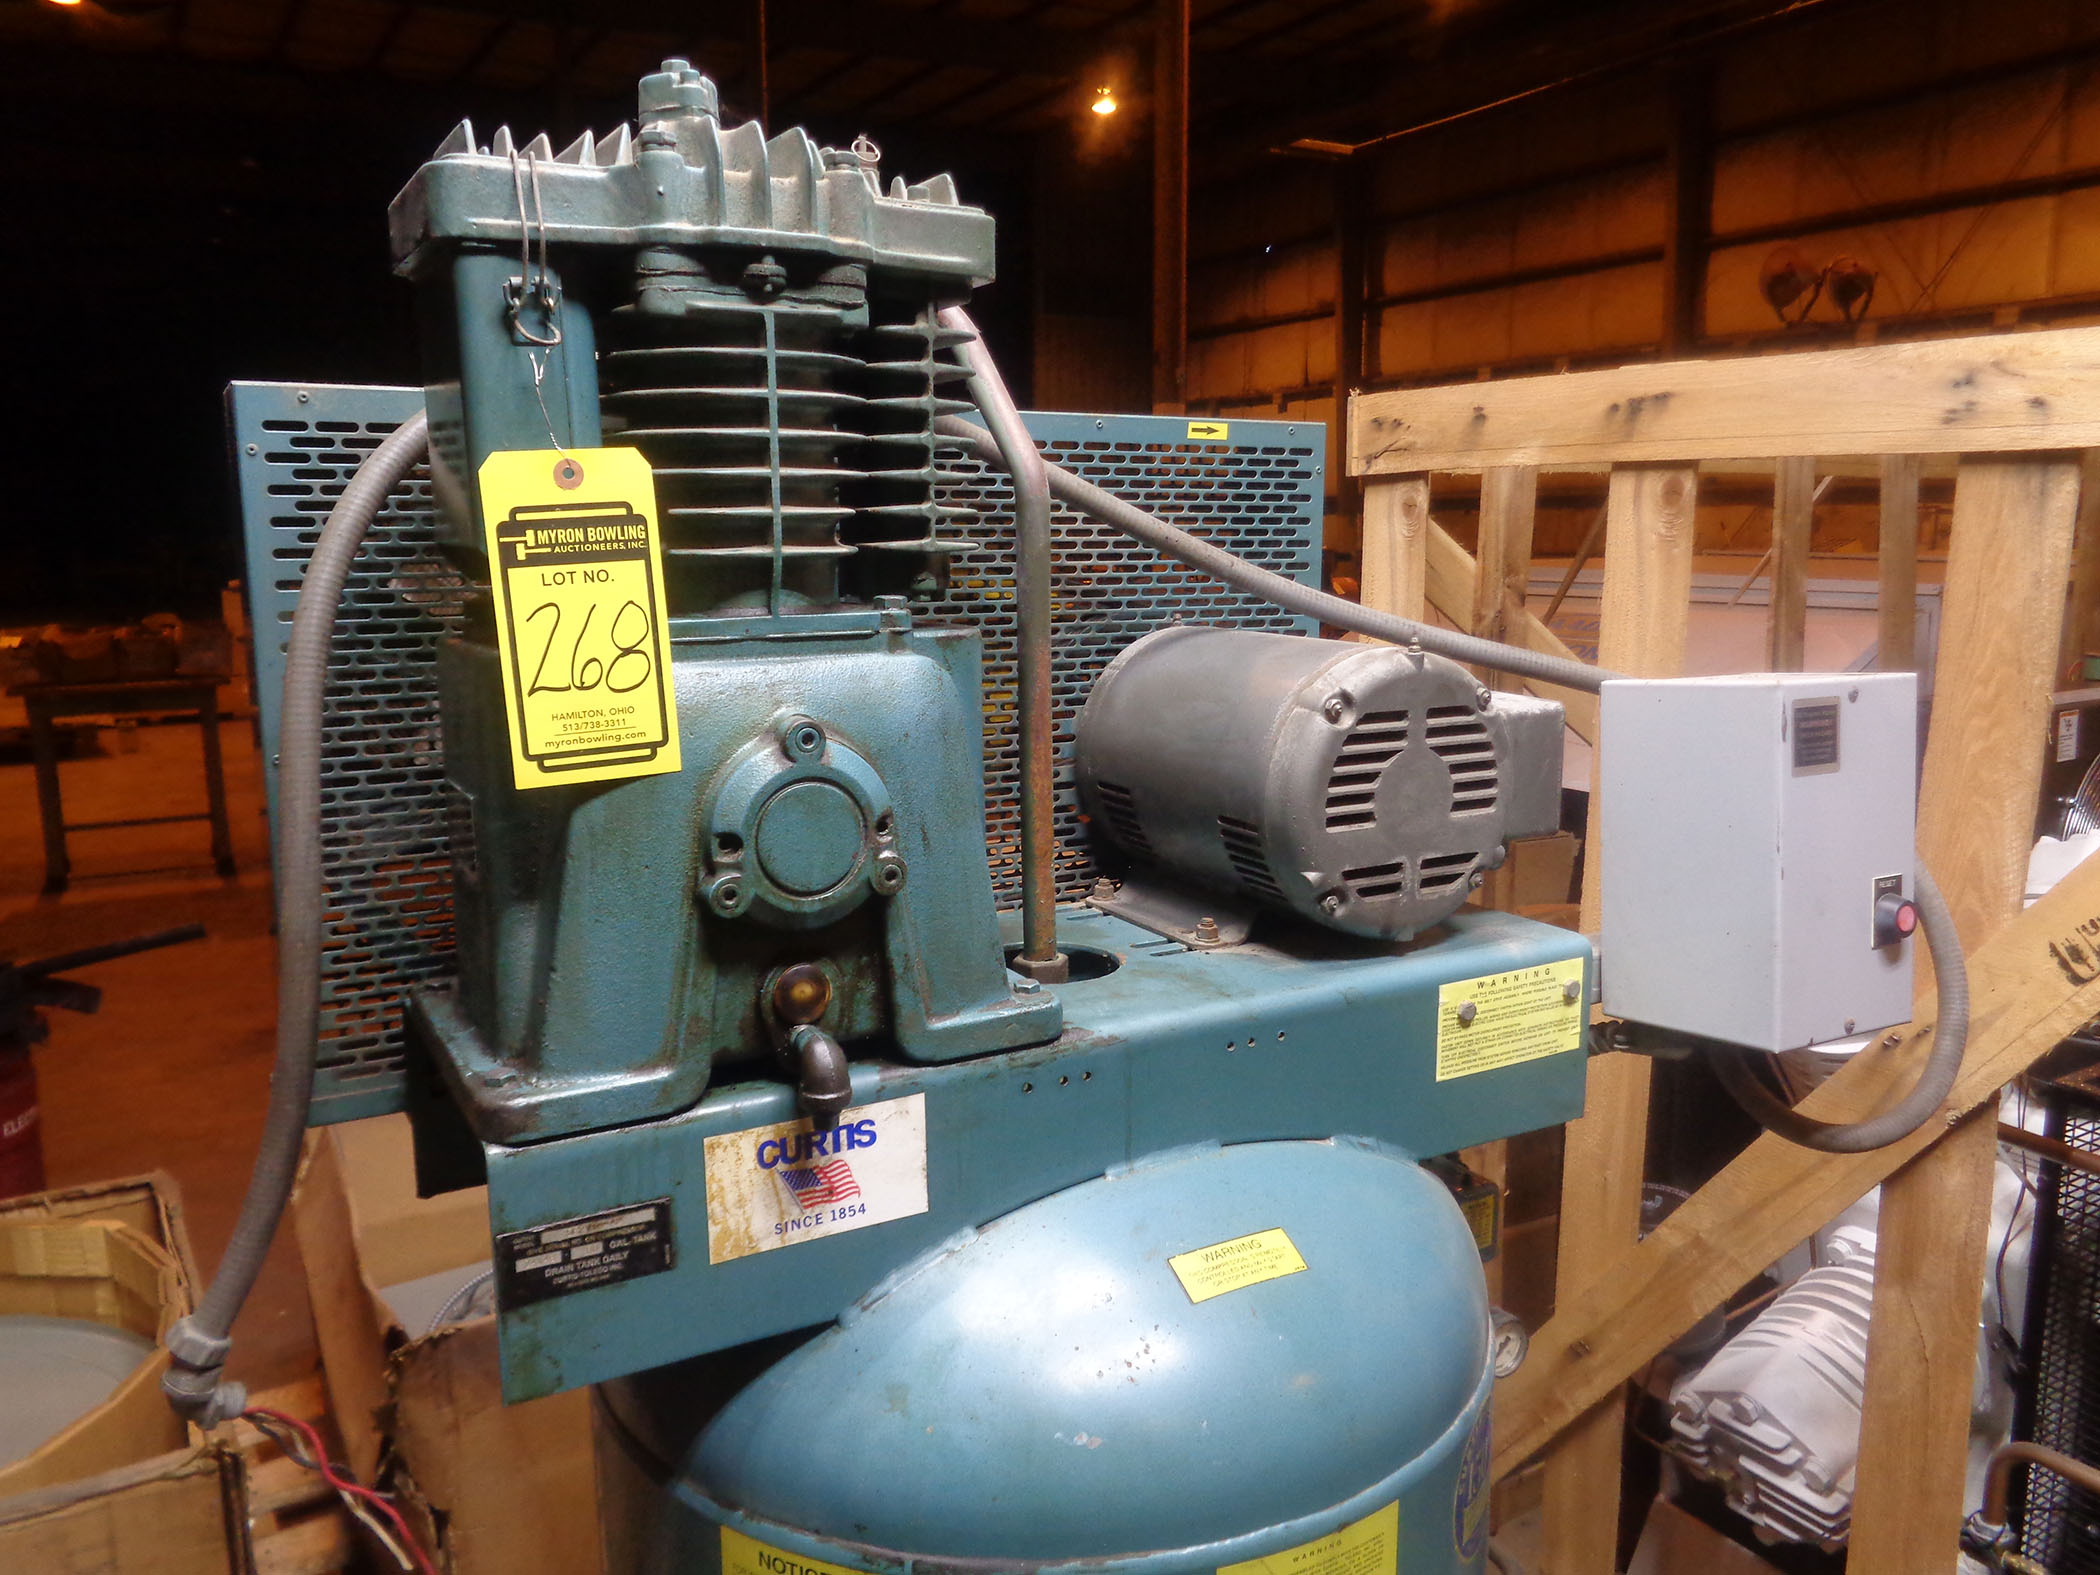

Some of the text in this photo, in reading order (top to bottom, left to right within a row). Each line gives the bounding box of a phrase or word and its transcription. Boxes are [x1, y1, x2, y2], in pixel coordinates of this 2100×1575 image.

[537, 525, 646, 545] MYRON BOWLING
[628, 541, 647, 549] INC.
[541, 569, 615, 586] LOT NO.
[526, 600, 651, 697] 268
[552, 706, 635, 721] HAMILTON, OHIO
[562, 718, 626, 732] 513/738-3311
[545, 731, 647, 749] myronbowling.com
[1477, 968, 1550, 989] WARNING
[757, 1119, 877, 1170] CURTIS
[774, 1203, 866, 1235] SINCE 1854
[1201, 1239, 1262, 1263] WARNING
[545, 1251, 629, 1278] DRAIN TANK DAILY
[1293, 1539, 1342, 1562] WARNING
